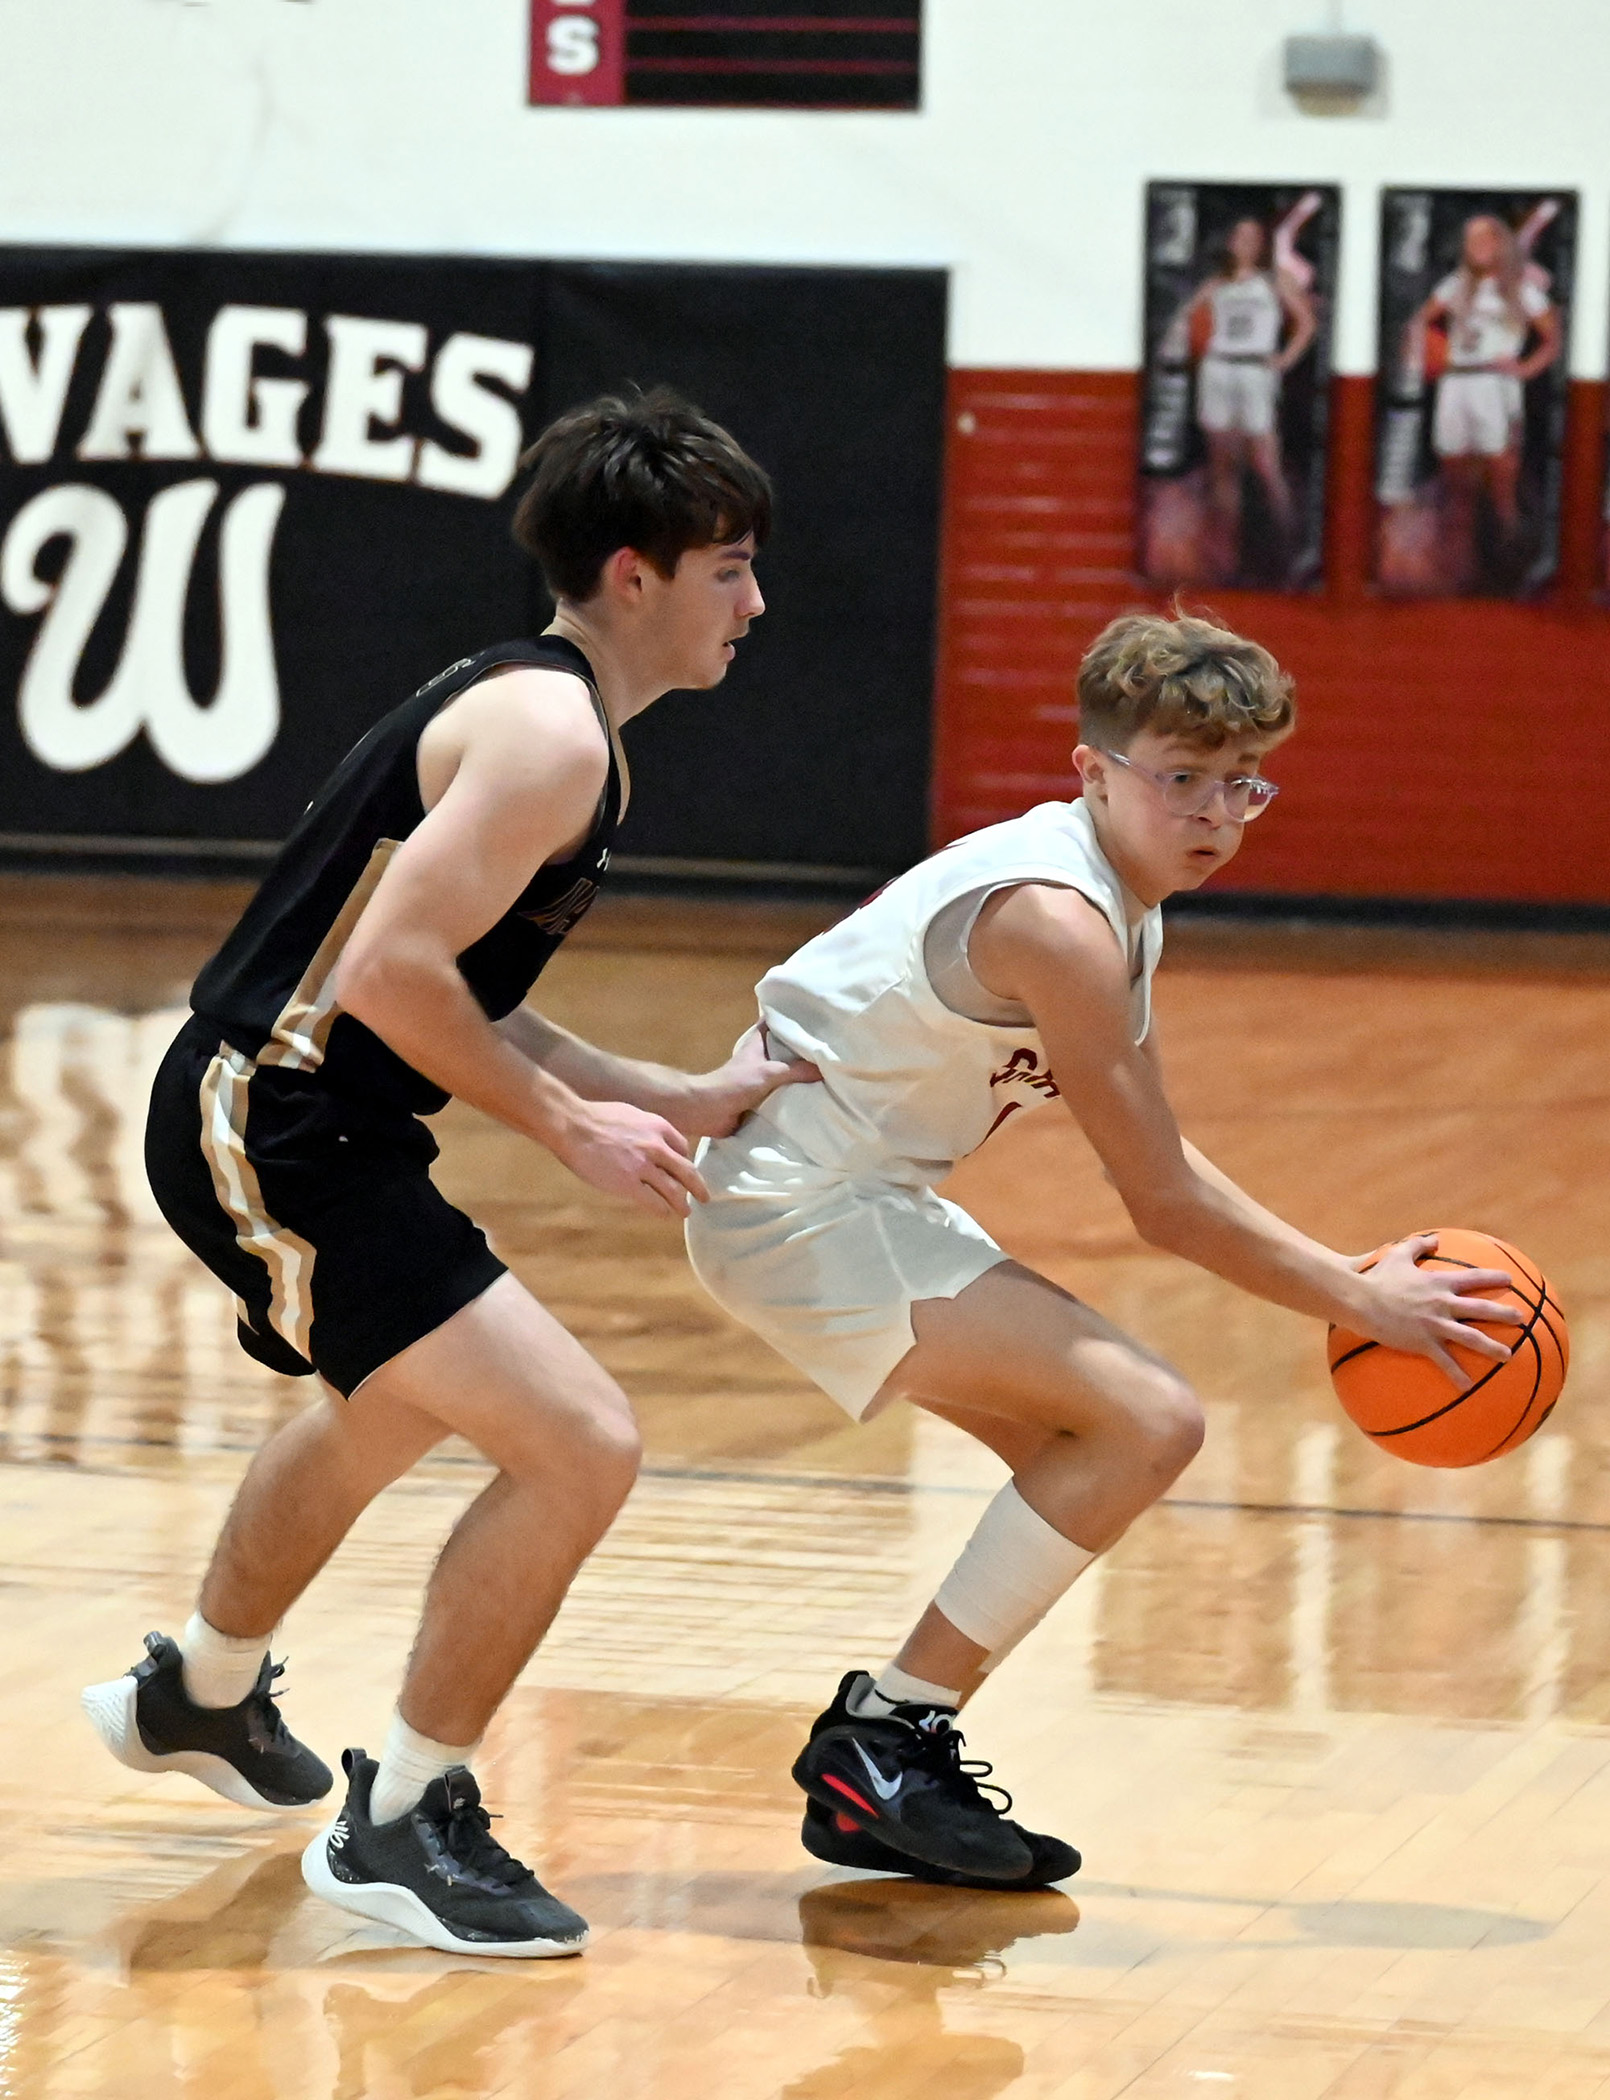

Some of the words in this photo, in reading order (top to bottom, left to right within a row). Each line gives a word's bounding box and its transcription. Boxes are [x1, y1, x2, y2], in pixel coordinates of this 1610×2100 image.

[546, 0, 599, 75] S
[0, 302, 535, 499] VAGES
[1, 480, 286, 783] W
